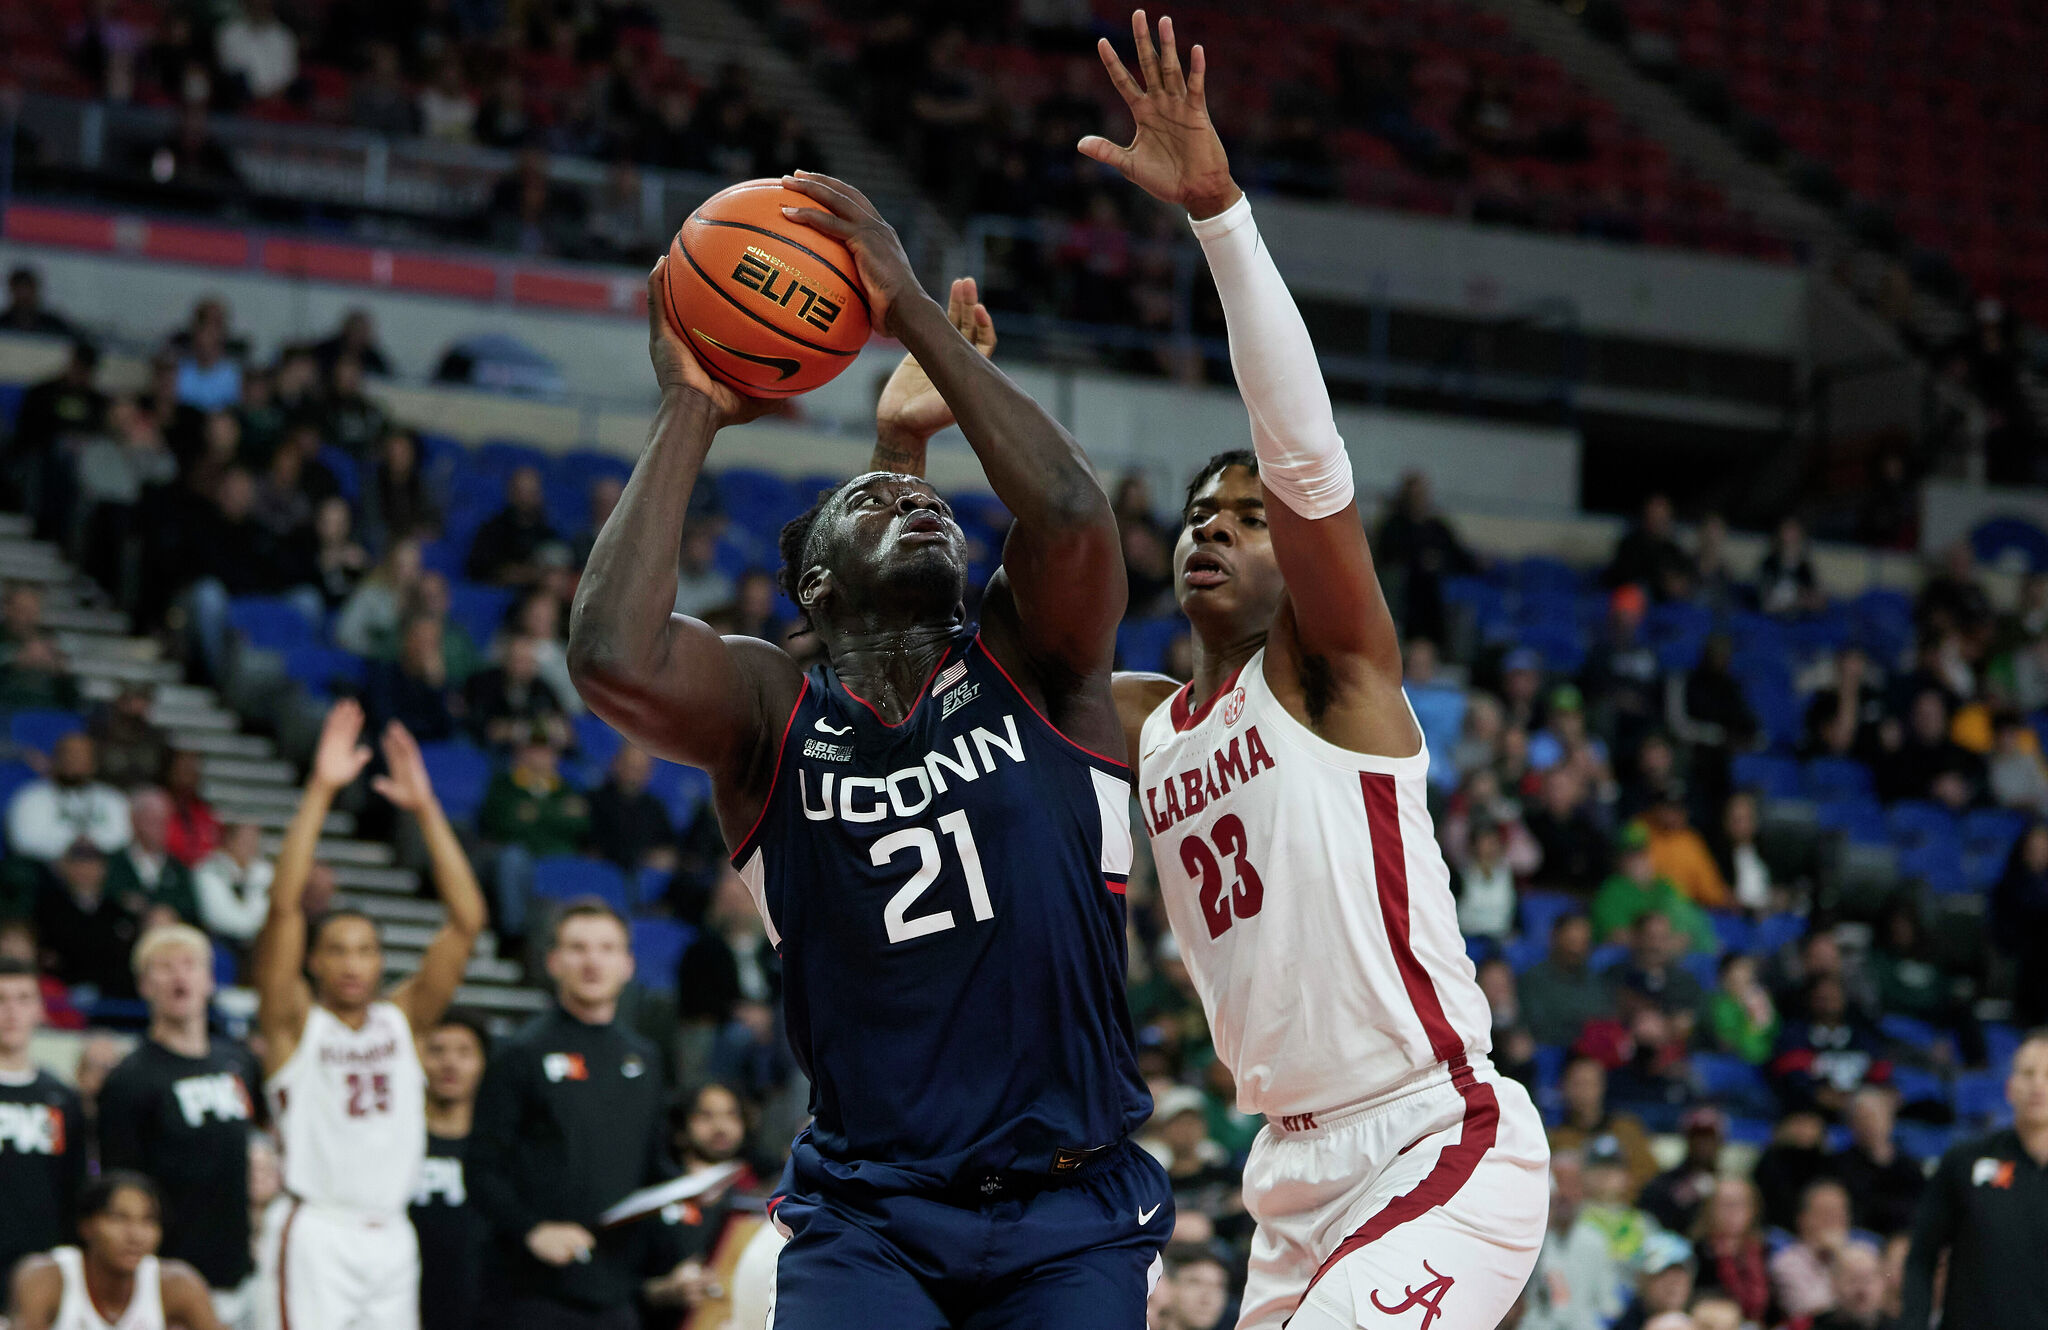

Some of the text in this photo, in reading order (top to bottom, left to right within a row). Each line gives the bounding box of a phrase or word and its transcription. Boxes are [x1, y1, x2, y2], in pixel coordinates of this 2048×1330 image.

[731, 251, 842, 333] ELITE
[942, 682, 980, 716] EAST
[943, 680, 969, 706] BIG
[1225, 687, 1244, 717] SEC
[798, 714, 1027, 824] UCONN
[802, 748, 852, 762] CHANGE
[869, 808, 995, 944] 21
[1180, 813, 1265, 940] 23
